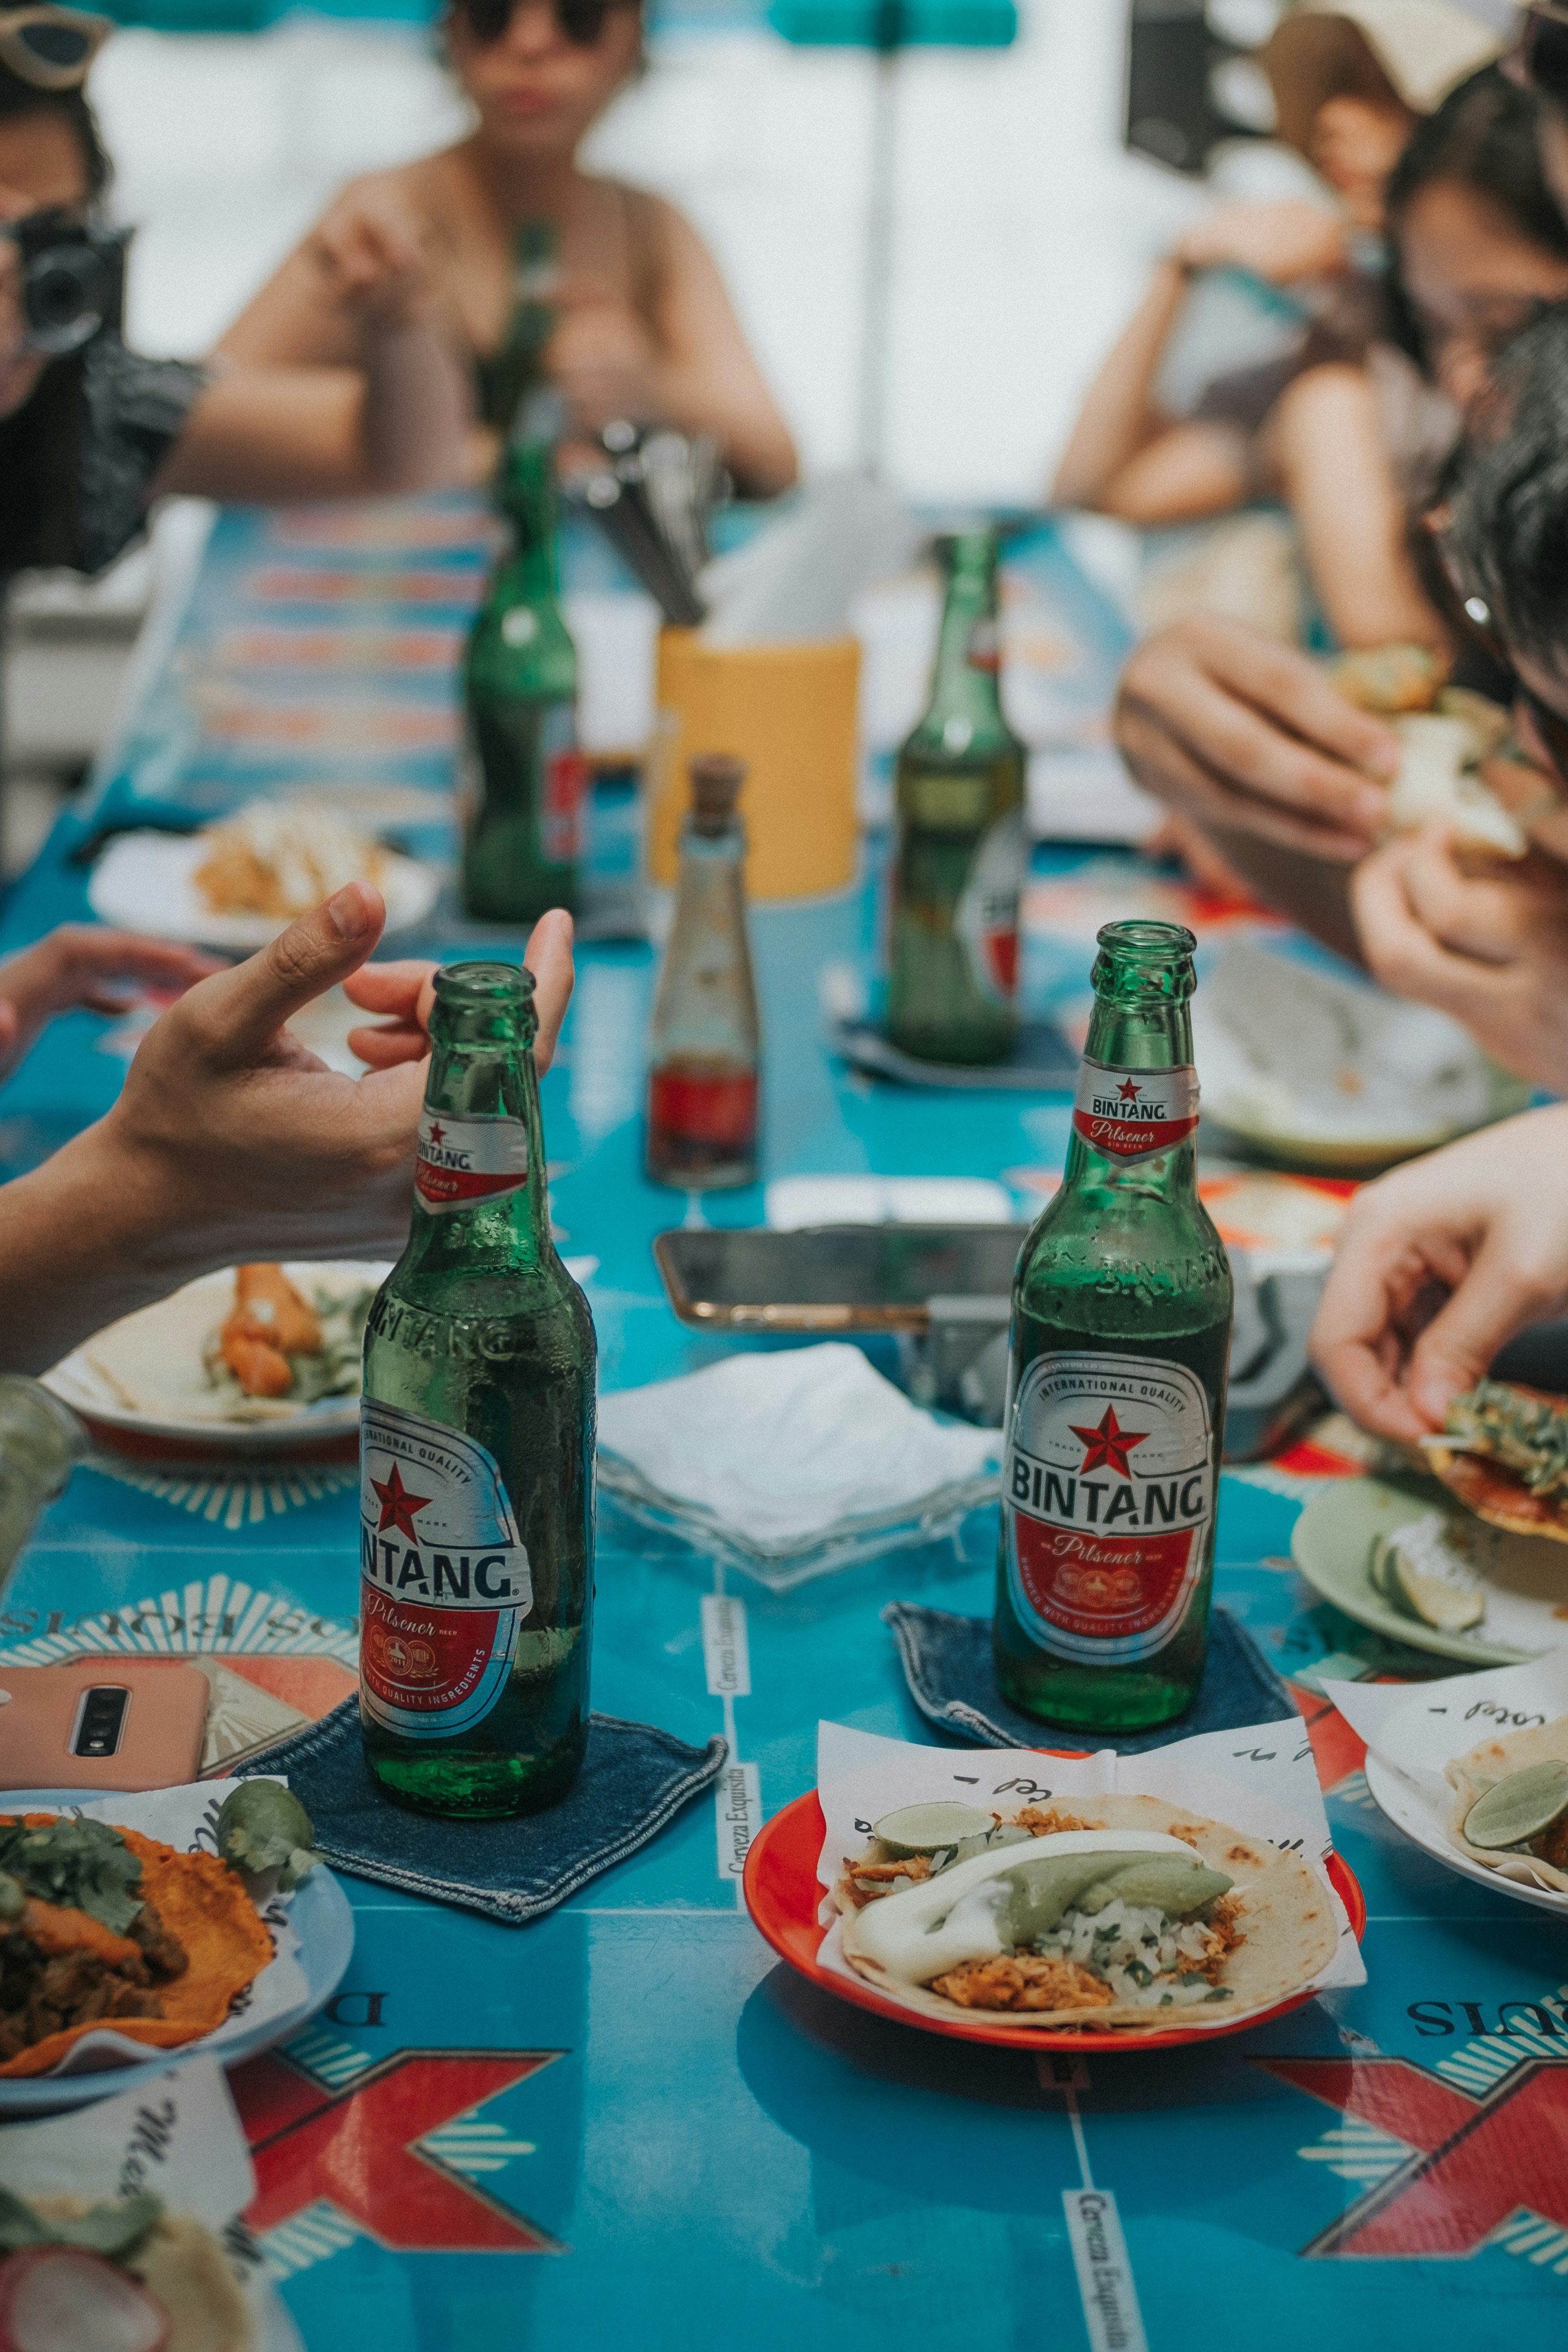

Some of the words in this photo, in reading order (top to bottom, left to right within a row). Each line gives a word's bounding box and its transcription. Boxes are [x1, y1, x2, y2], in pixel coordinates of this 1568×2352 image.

[1093, 1099, 1165, 1119] BINTANG
[1090, 1121, 1155, 1143] Pilsener
[1039, 1379, 1134, 1399] INTERNATIONAL
[1140, 1385, 1186, 1413] QUALITY
[1049, 1441, 1082, 1453] TRADE
[418, 1448, 472, 1484] QUALITY
[1011, 1455, 1203, 1525] BINTANG
[417, 1519, 447, 1527] MARK
[1052, 1535, 1143, 1564] Pilsener
[1021, 1557, 1041, 1604] BREWED
[1043, 1605, 1069, 1624] WITH
[1074, 1620, 1125, 1632] QUALITY
[367, 1588, 436, 1637] Pilsener
[383, 1685, 422, 1705] QUALITY
[428, 1649, 486, 1705] INGREDIENTS
[724, 1768, 753, 1822] Exquisita
